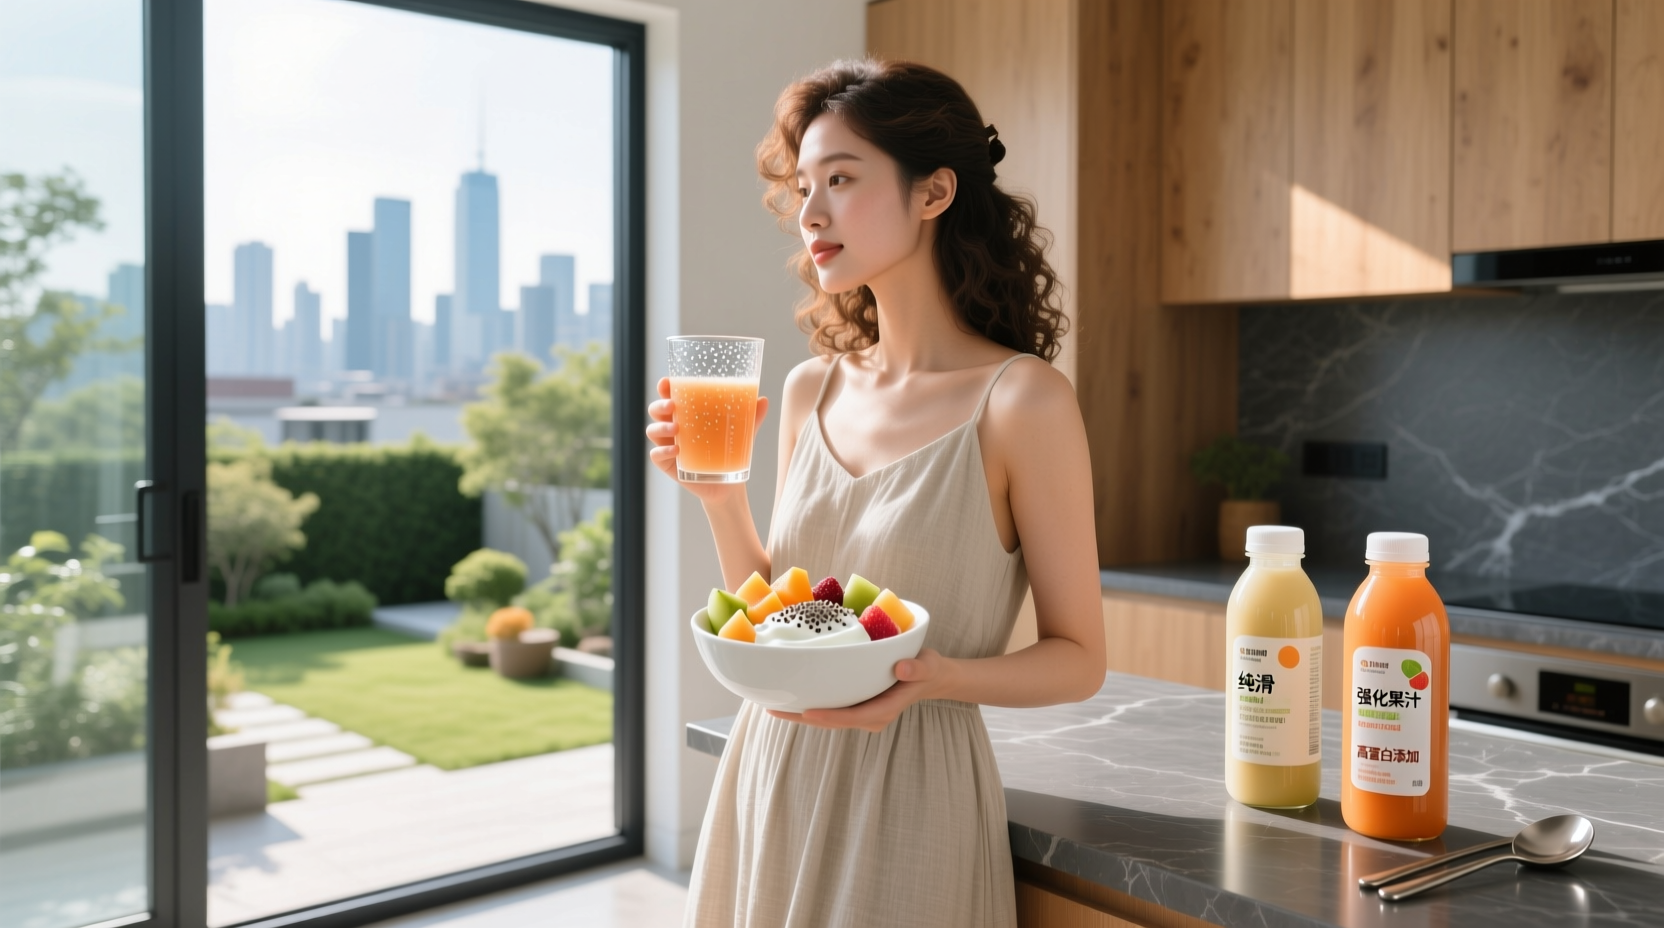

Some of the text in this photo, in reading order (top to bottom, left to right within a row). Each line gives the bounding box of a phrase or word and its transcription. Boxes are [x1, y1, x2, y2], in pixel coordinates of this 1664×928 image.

[1238, 670, 1275, 694] 纯滑
[1357, 686, 1421, 709] 强化果汁
